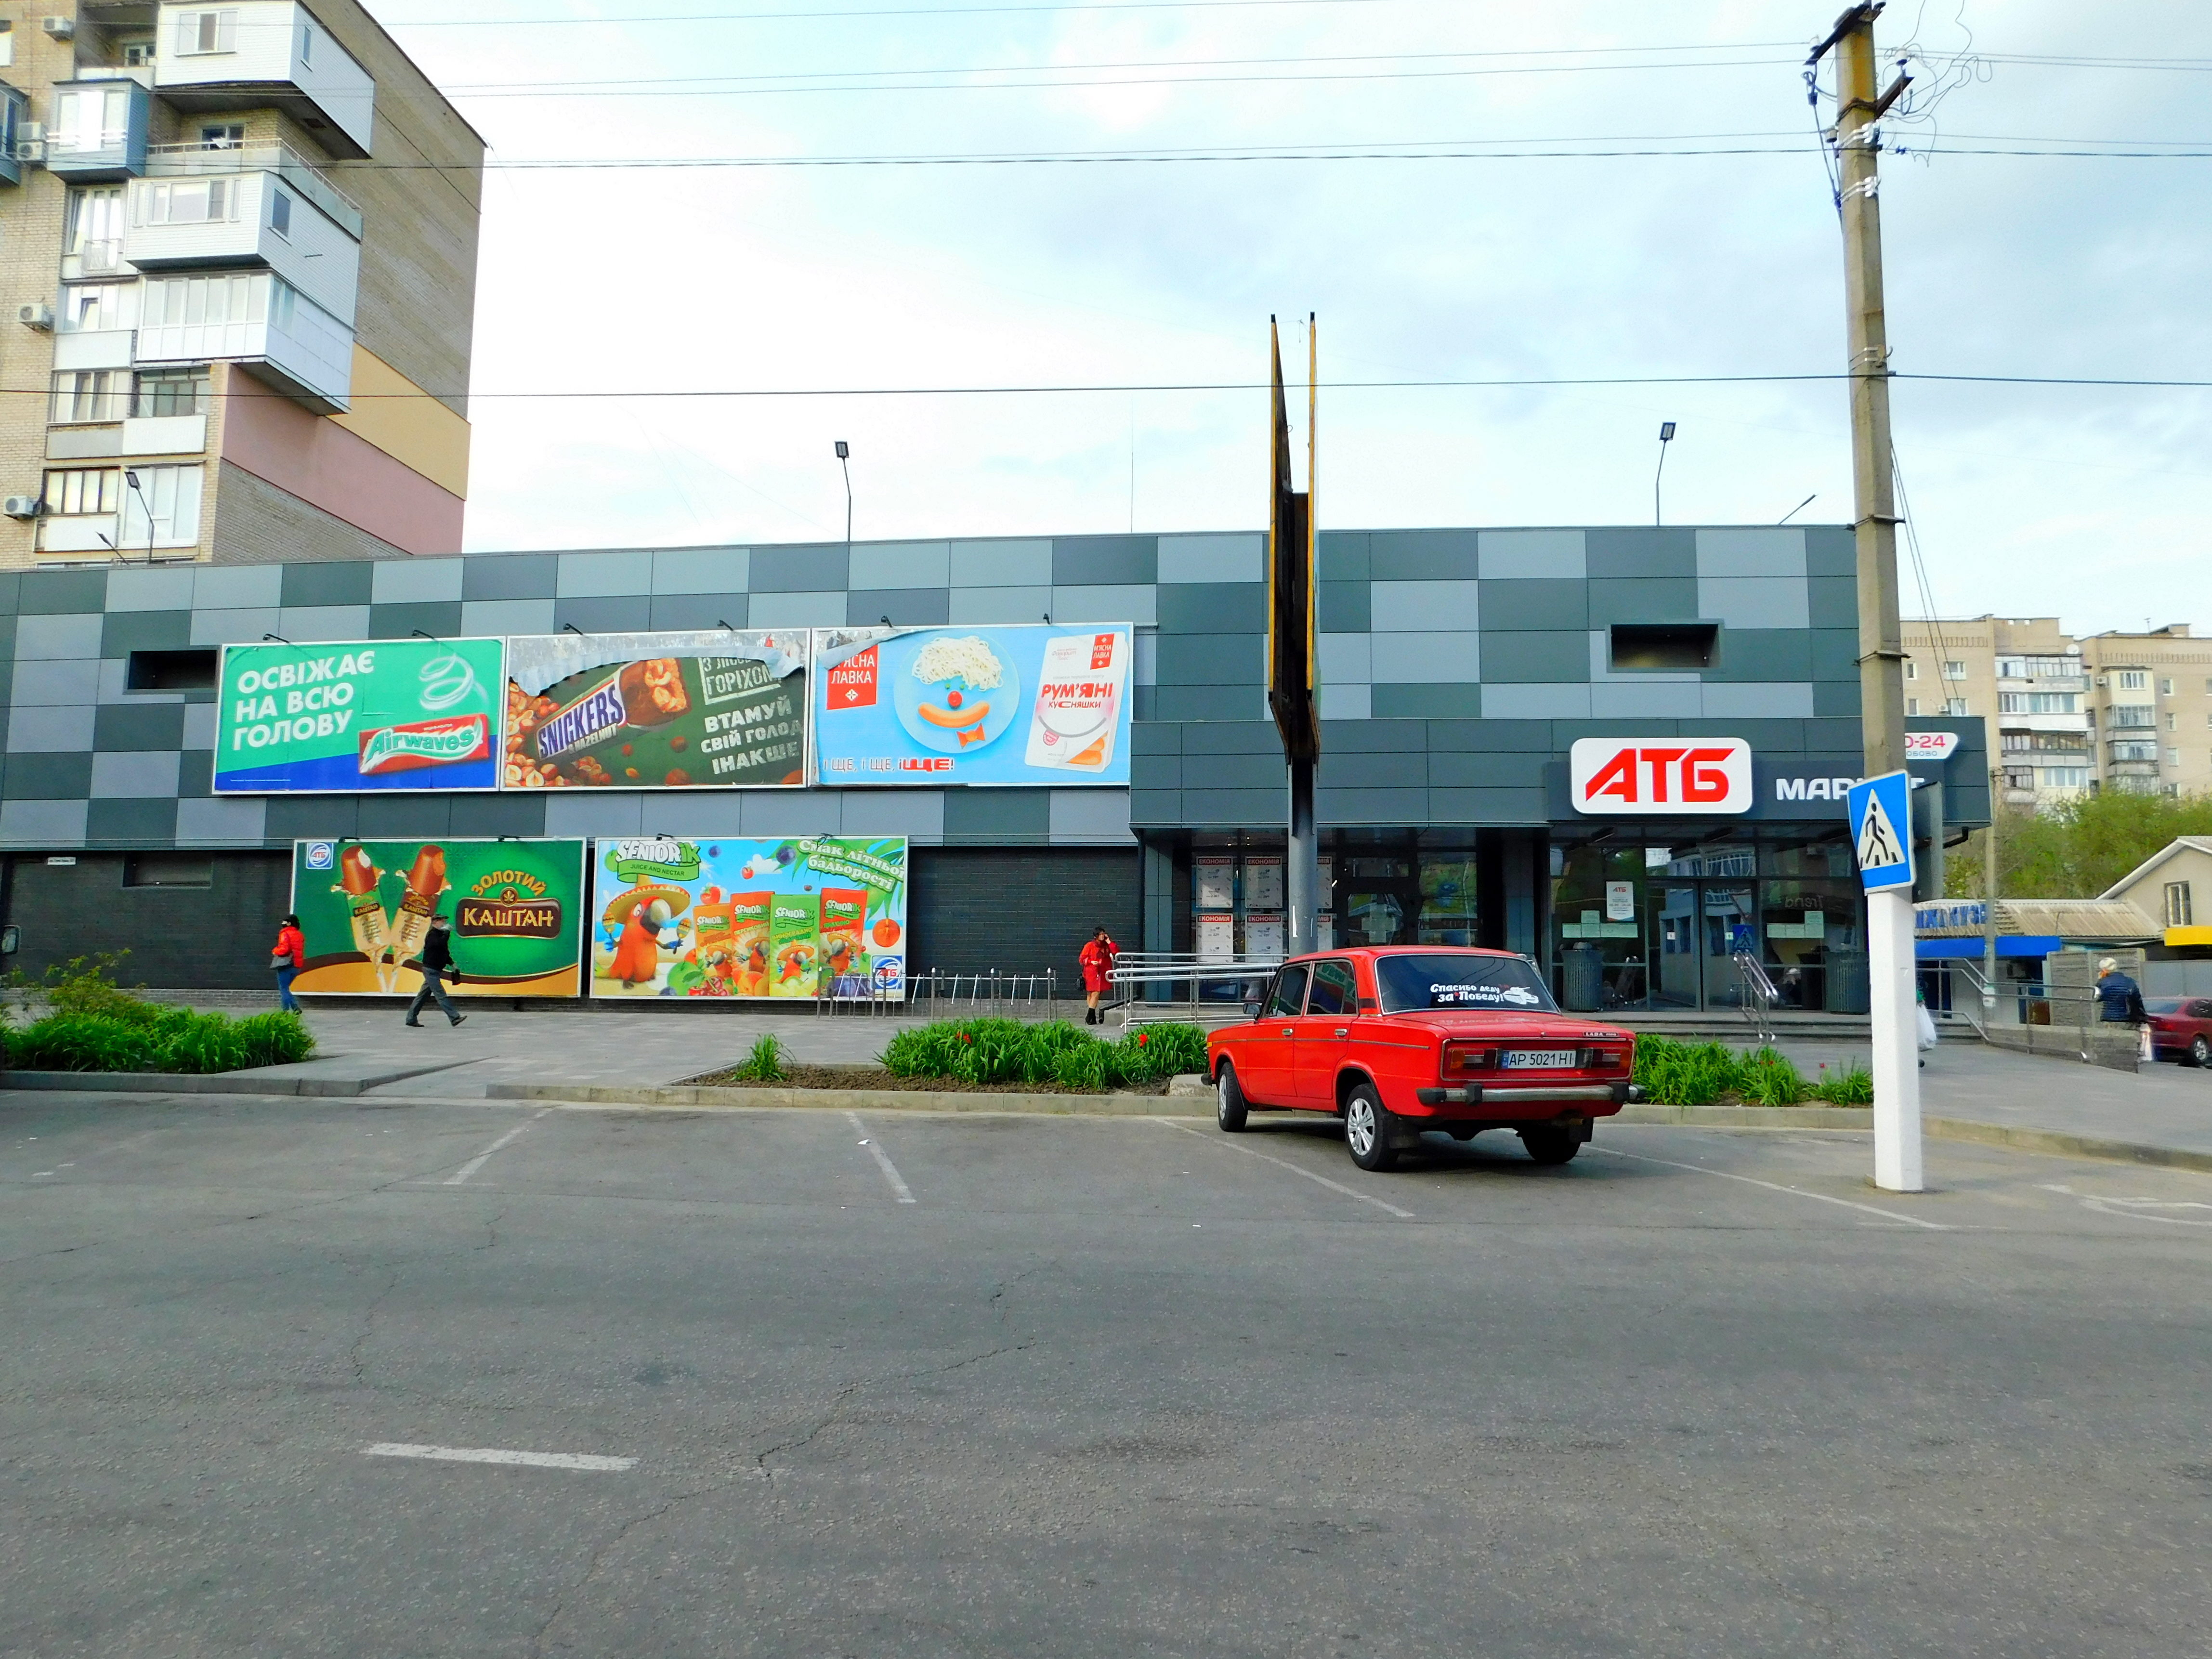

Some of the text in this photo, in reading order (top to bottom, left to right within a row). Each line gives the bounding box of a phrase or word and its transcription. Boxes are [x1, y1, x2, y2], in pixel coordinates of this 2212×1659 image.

[238, 651, 375, 693] ОСВІЖАЄ
[838, 654, 875, 667] ЯСНА
[831, 670, 872, 684] ЛАВКА
[236, 682, 354, 722] НА ВСЮ
[704, 695, 792, 732] ВТАМУЙ
[234, 709, 353, 751] ГОЛОВУ
[538, 684, 623, 758] SNICKERS
[701, 720, 803, 753] СВІЙ ГОЛОД
[366, 729, 474, 761] Airwaves
[712, 742, 799, 774] ІНАКШЕ
[1585, 748, 1735, 802] АТБ
[799, 840, 843, 856] Смак
[471, 870, 546, 896] ЗОЛОТИЙ
[808, 855, 893, 890] бадьорості
[464, 908, 554, 927] КАШТАН
[1430, 983, 1477, 993] Спасибо
[1438, 991, 1505, 1003] за Победу!
[1509, 1053, 1572, 1066] AP 5021 HI
